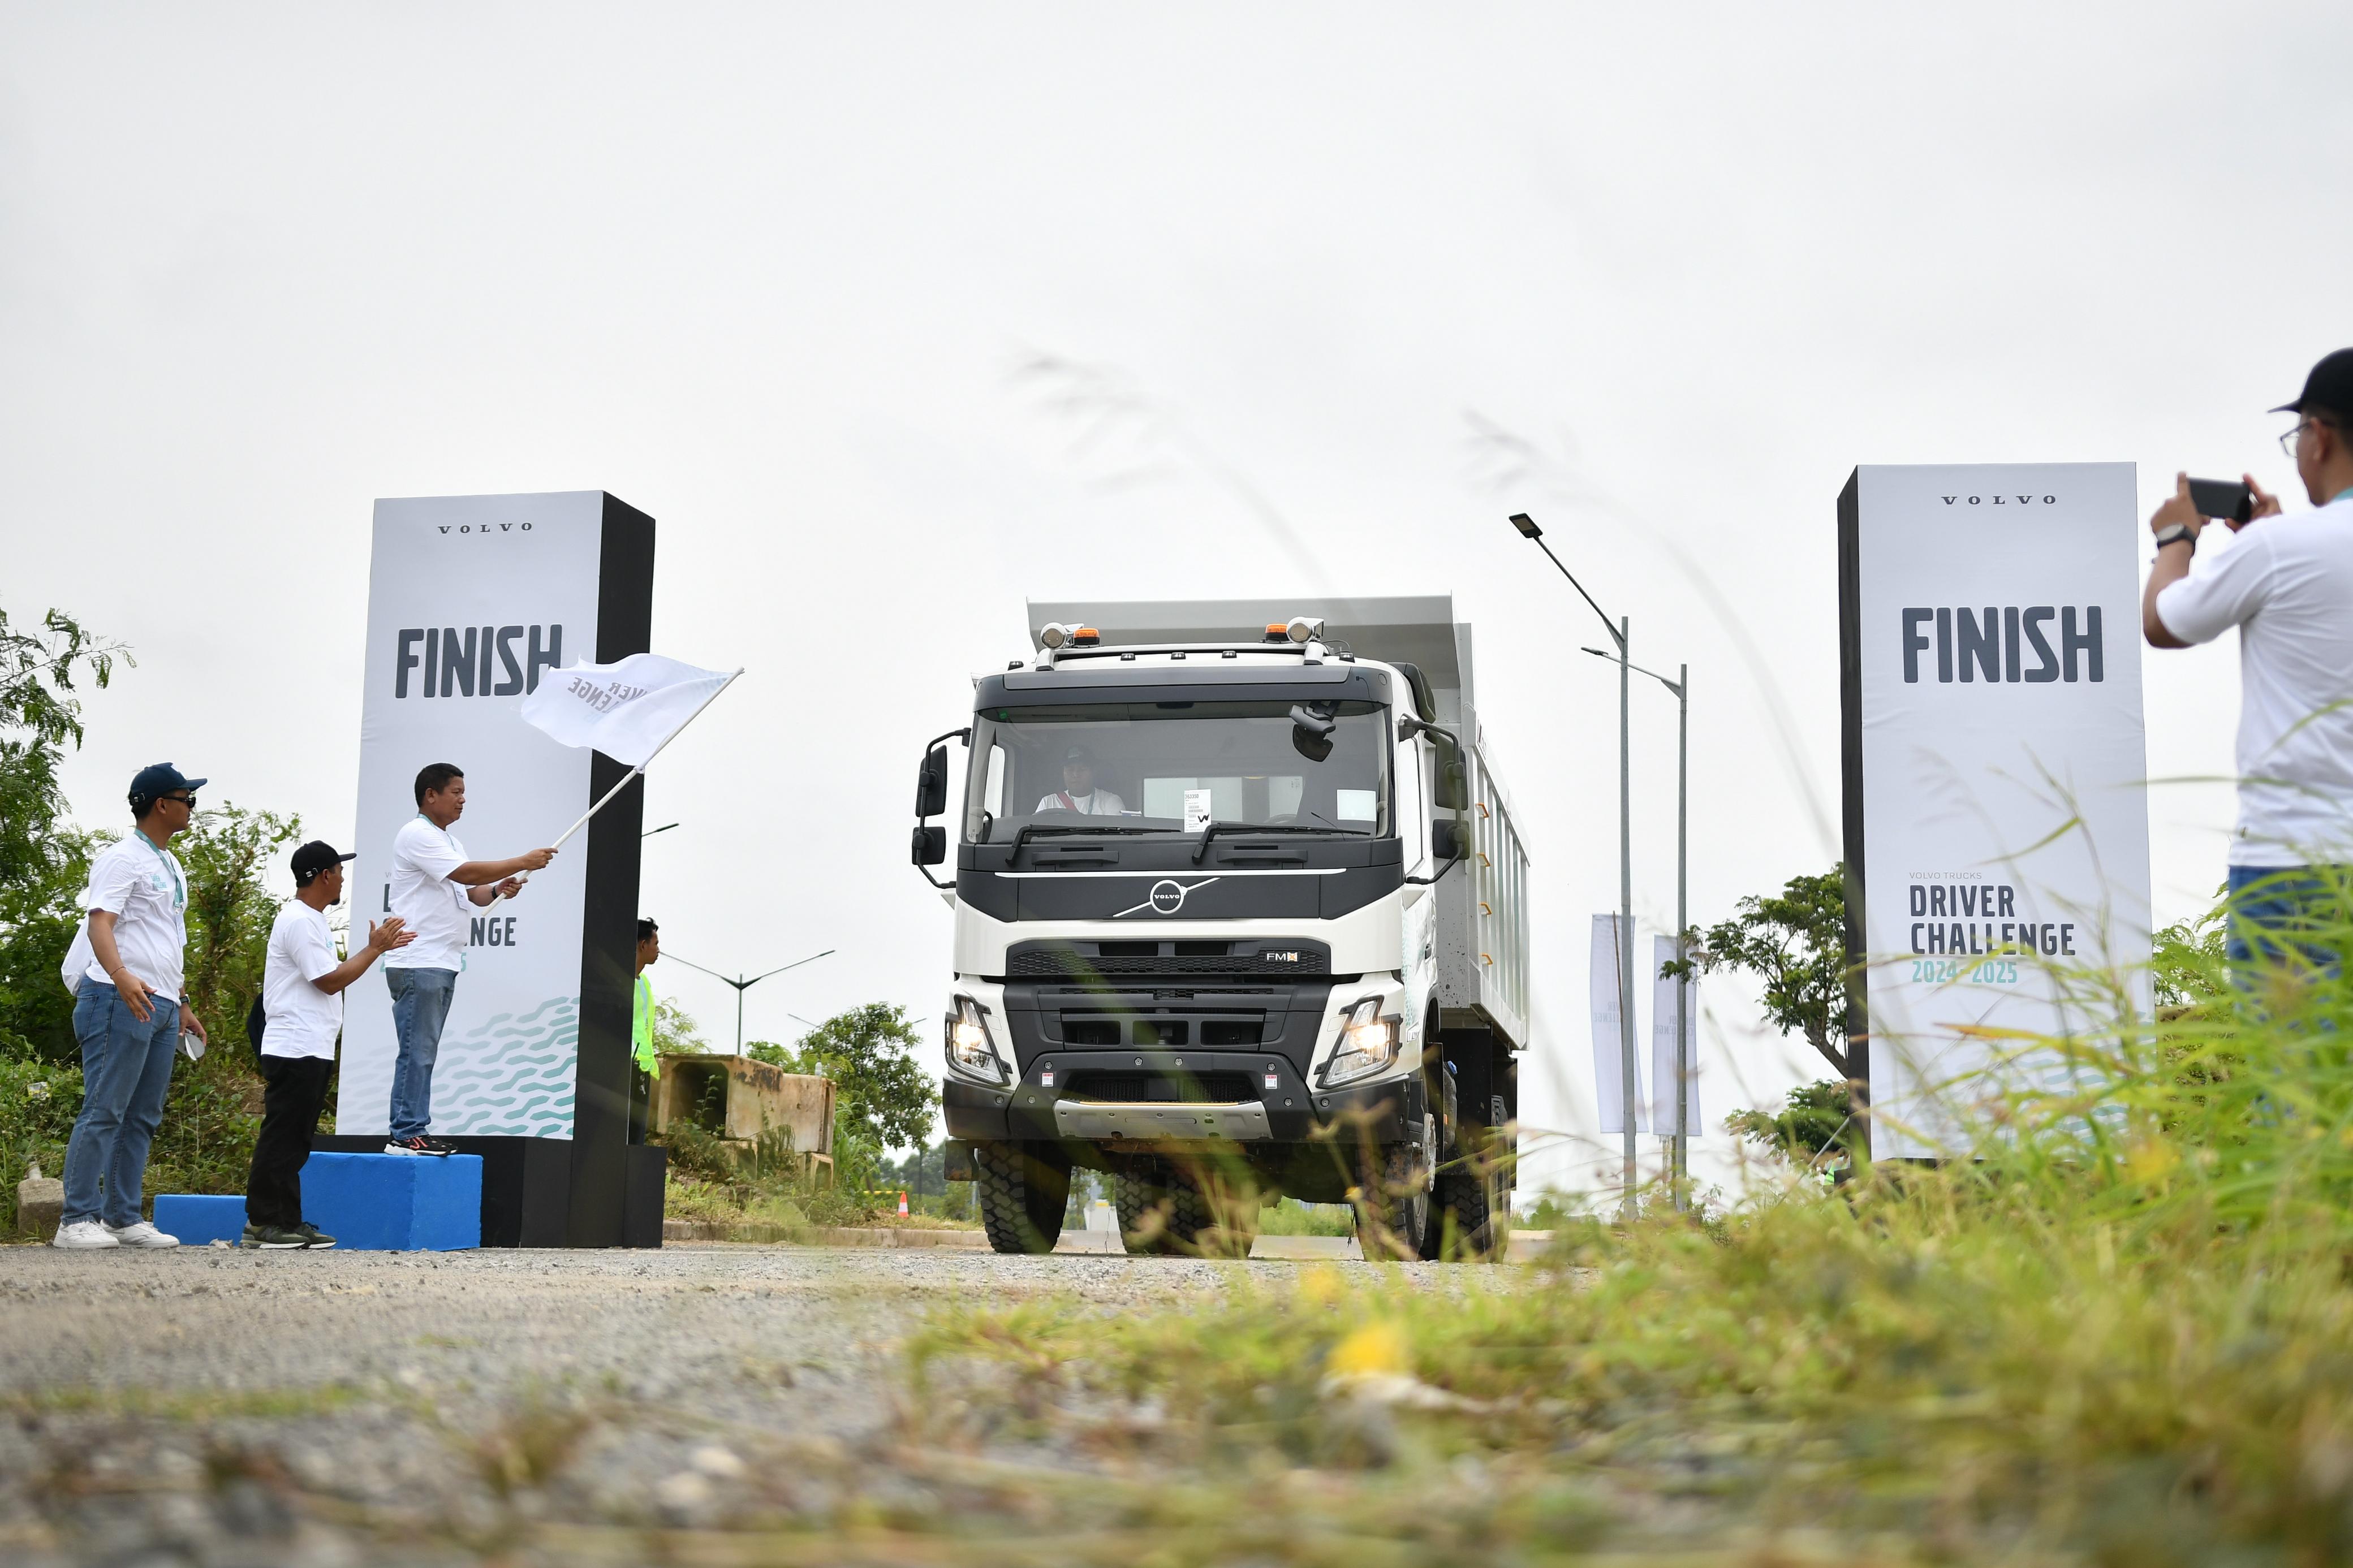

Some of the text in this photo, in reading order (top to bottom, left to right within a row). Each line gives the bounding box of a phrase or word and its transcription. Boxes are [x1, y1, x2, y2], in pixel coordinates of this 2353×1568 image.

[1941, 495, 2056, 505] VOLVO
[437, 522, 532, 534] VOLVO
[1902, 606, 2104, 683] FINISH
[395, 624, 562, 699] FINISH
[1910, 885, 2015, 917] DRIVER
[1911, 923, 2076, 956] CHALLENGE
[1266, 952, 1298, 962] FMX
